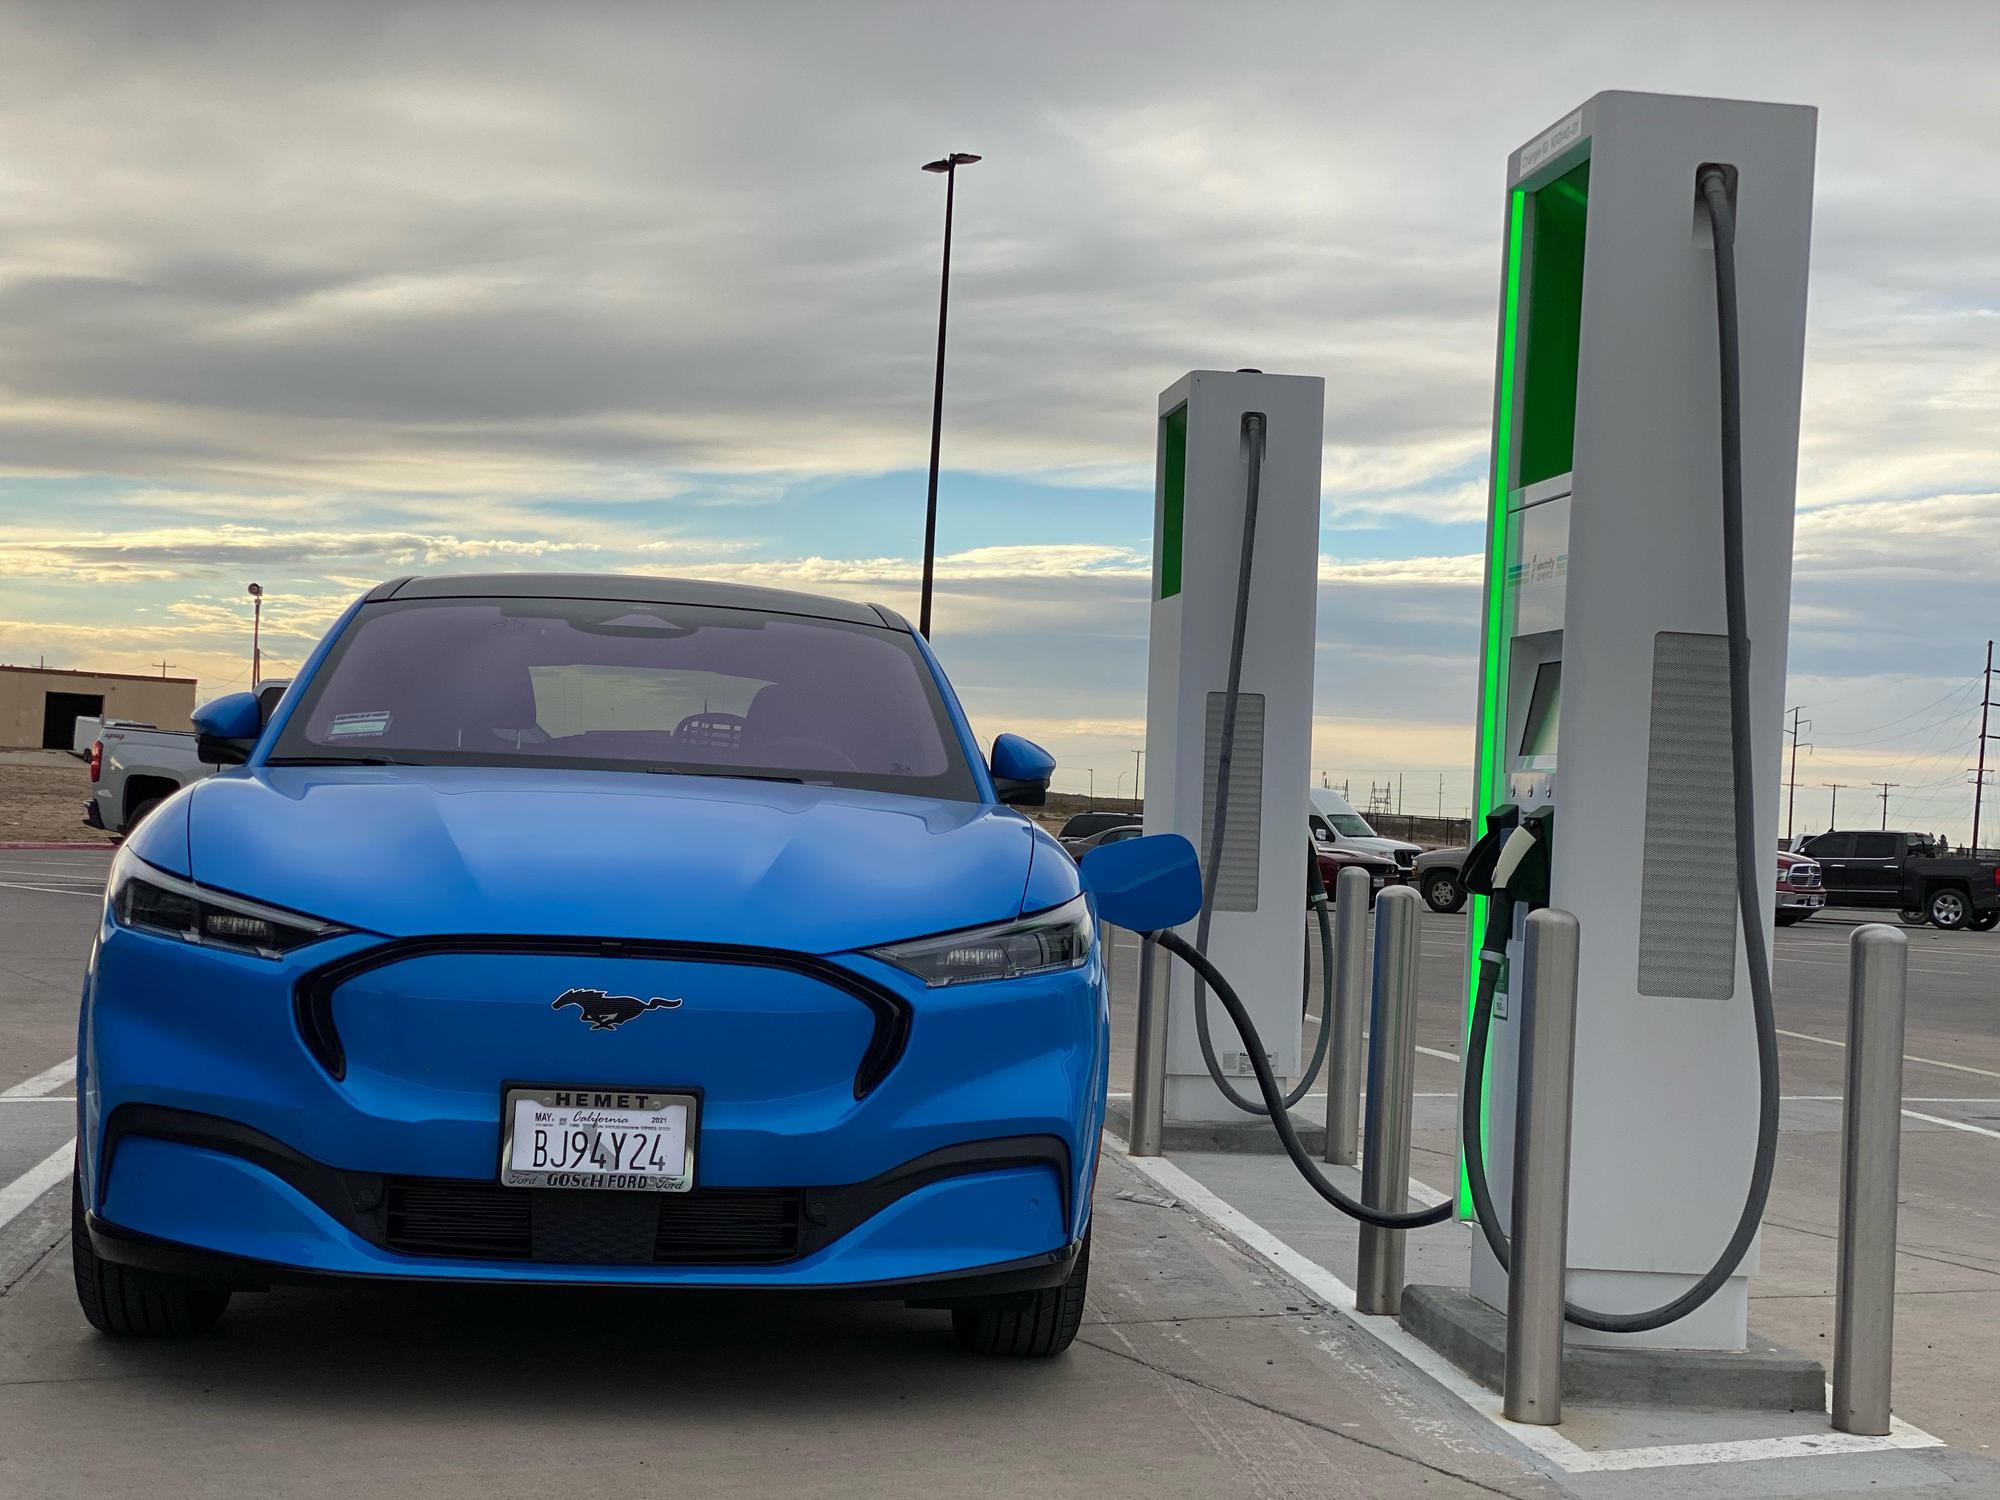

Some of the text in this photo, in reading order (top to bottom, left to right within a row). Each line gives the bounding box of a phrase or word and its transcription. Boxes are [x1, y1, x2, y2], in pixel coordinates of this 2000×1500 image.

[555, 1092, 649, 1109] HEMET
[573, 1110, 629, 1128] California
[533, 1129, 666, 1172] BJ94Y24
[508, 1172, 537, 1185] Ford
[607, 1175, 648, 1189] FORD
[655, 1176, 685, 1190] Ford
